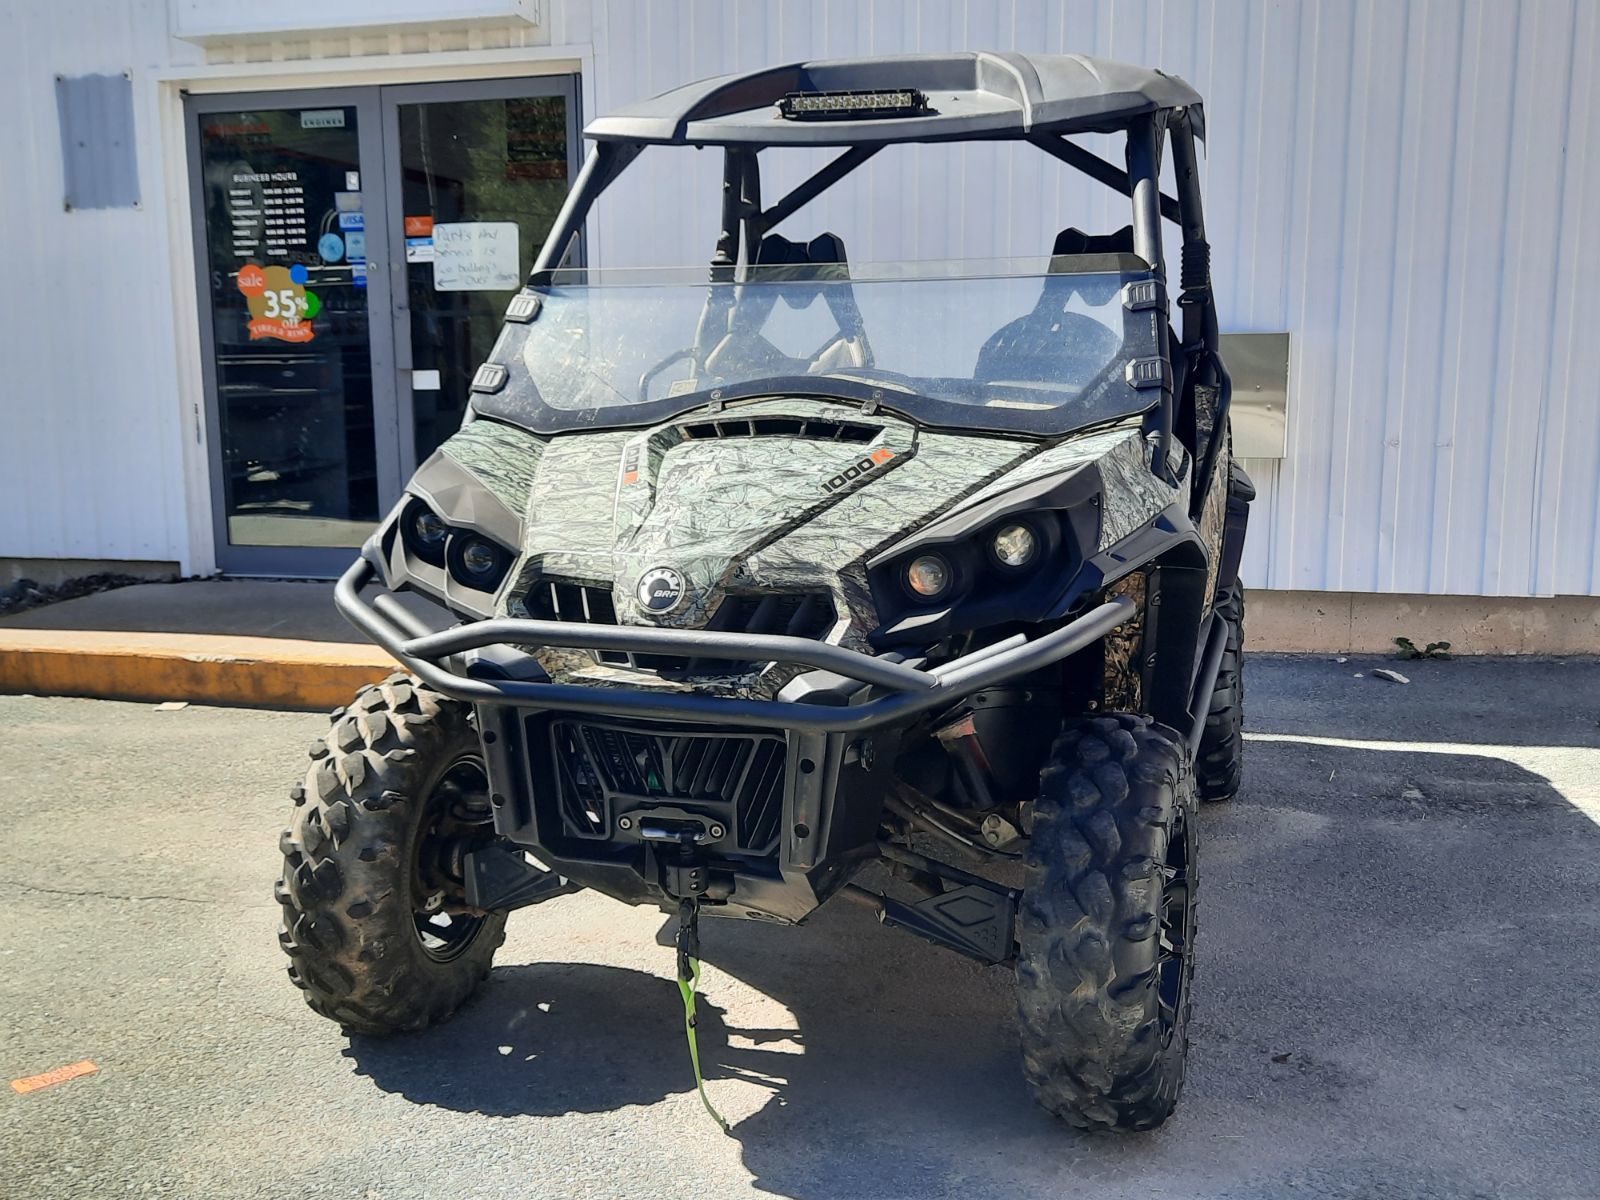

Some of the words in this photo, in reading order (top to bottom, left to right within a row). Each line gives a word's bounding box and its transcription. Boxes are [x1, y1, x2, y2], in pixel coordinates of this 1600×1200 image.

[343, 215, 364, 225] VISA
[238, 272, 263, 287] sale
[263, 289, 309, 318] 35%
[820, 447, 896, 493] 1000R
[653, 589, 679, 598] BRP
